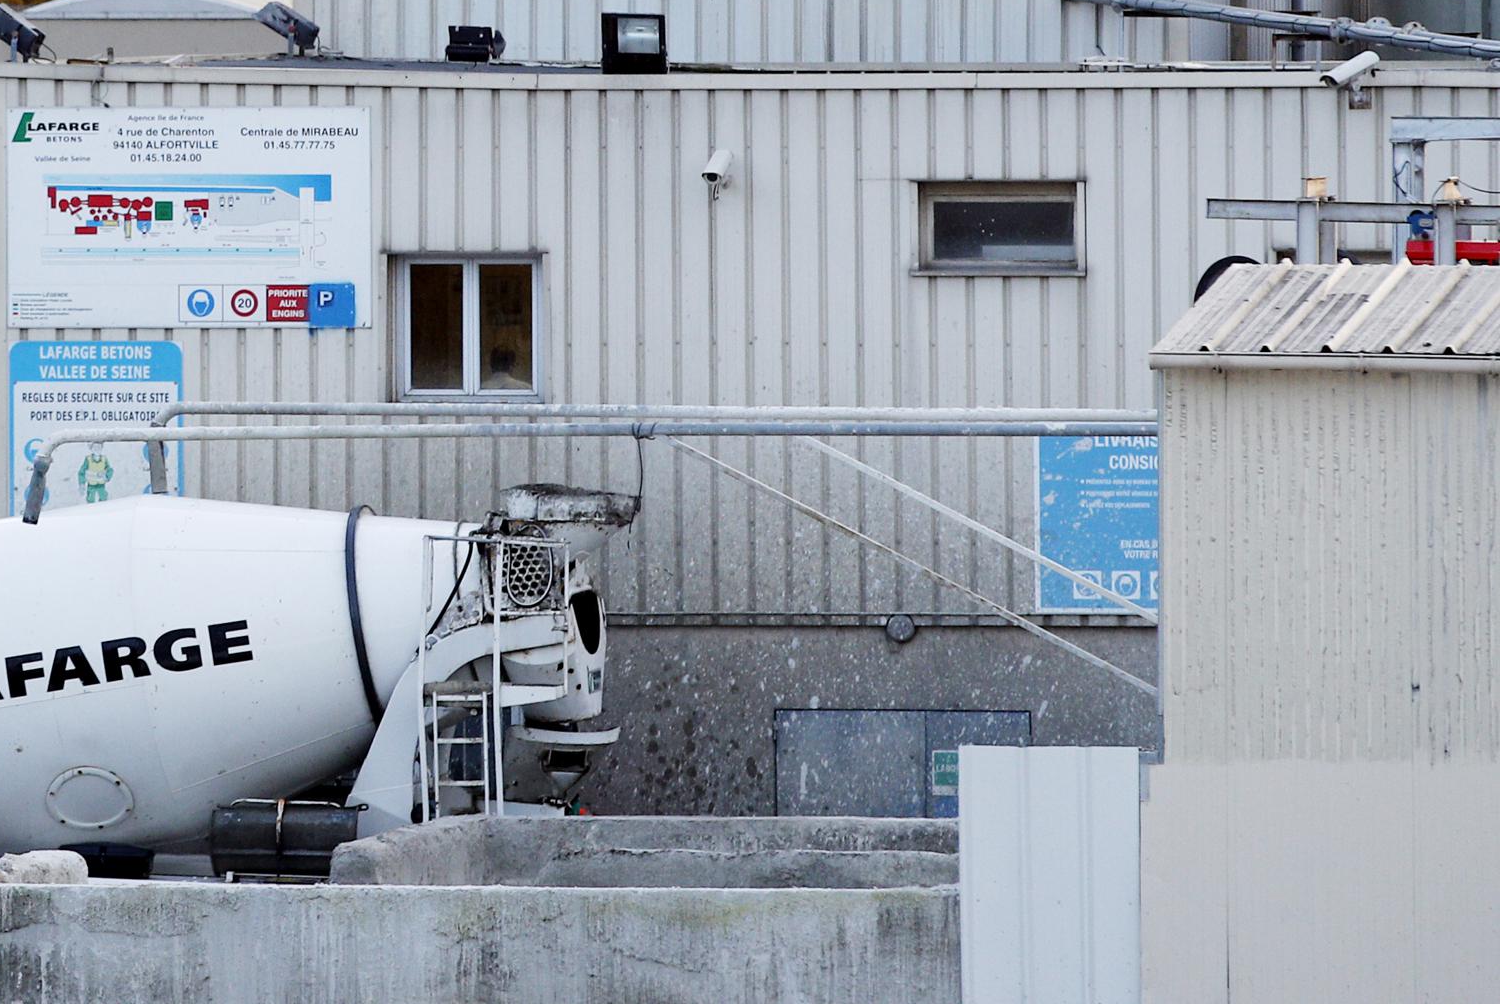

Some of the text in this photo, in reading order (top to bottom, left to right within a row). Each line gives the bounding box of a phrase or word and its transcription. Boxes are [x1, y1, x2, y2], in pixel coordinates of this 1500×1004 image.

[128, 114, 155, 122] Agence
[27, 122, 99, 132] LAFARGE
[117, 128, 123, 136] 4
[145, 127, 158, 136] de
[161, 127, 215, 136] Charenton
[240, 127, 359, 136] Centrale de MIRABEAU
[113, 140, 219, 149] 94140 ALFORTVILLE
[263, 140, 335, 149] 01.45.77.77.75
[59, 155, 69, 163] de
[70, 155, 91, 163] Seine
[130, 153, 202, 162] 01.45.18.24.00
[267, 289, 308, 298] PRIORITE
[237, 298, 252, 309] 20
[279, 299, 298, 308] AUX
[319, 291, 333, 307] P
[271, 309, 305, 318] ENGINS
[39, 346, 152, 360] LAFARGE BETONS
[39, 365, 151, 379] VALLEE DE SEINE
[22, 392, 170, 403] REGLES DE SECURITE SUR CE SITE
[30, 411, 160, 421] PORT DES E.P.I. OBLIGATOIR
